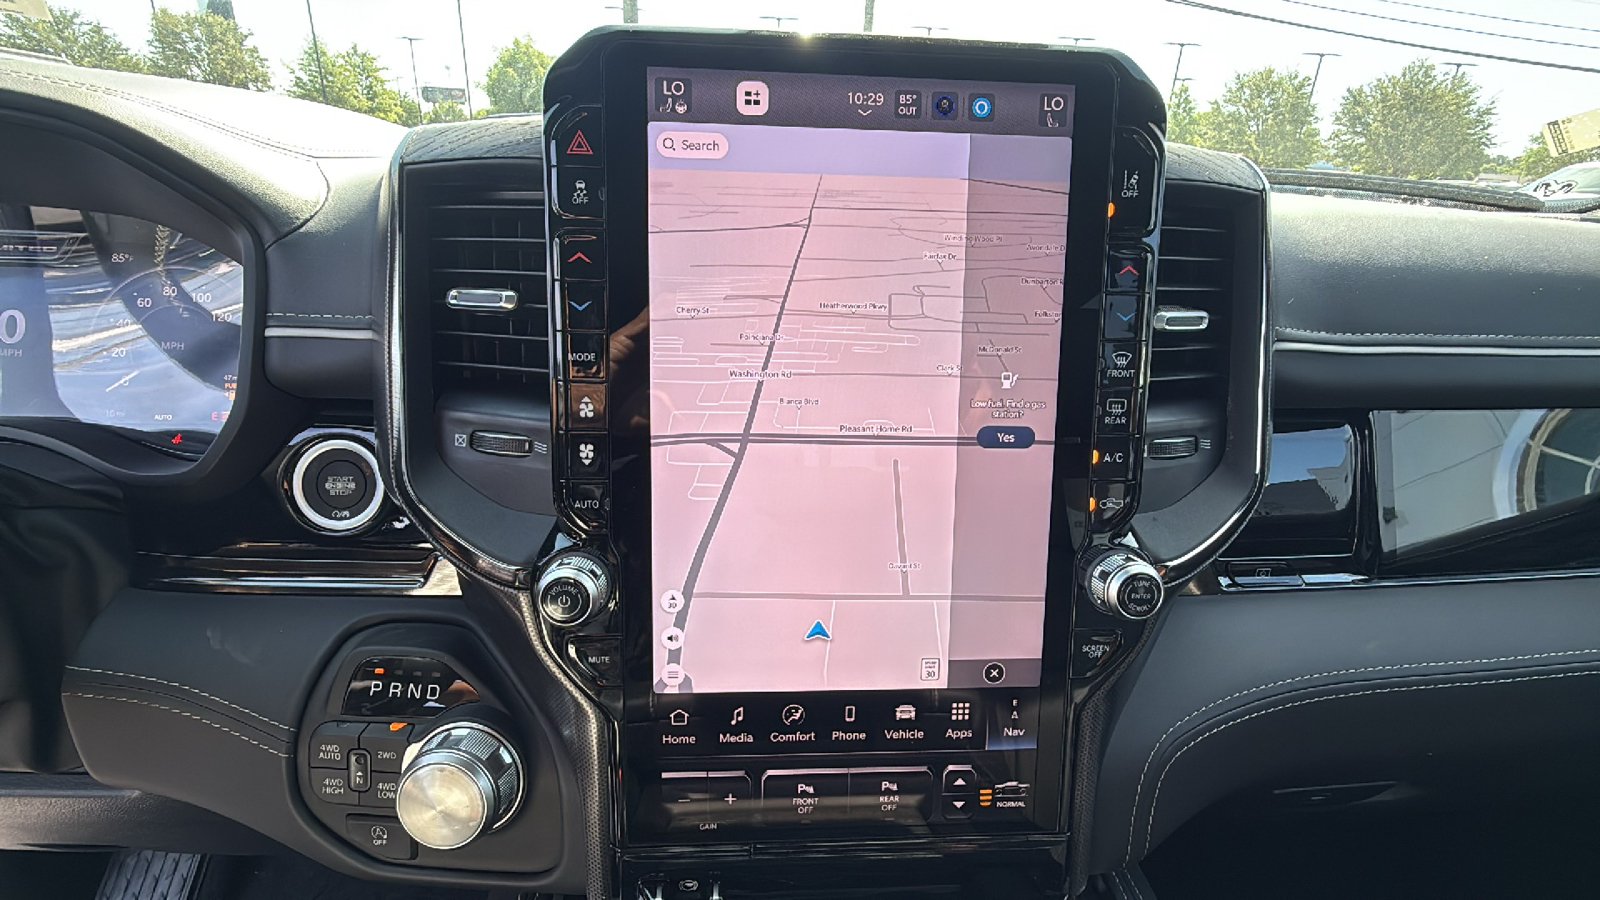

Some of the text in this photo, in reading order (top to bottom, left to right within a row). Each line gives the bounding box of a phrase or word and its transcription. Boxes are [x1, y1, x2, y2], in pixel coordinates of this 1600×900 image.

[662, 80, 685, 96] LO
[847, 92, 884, 106] 10:29
[899, 94, 916, 104] 85°
[1043, 96, 1064, 112] LO
[898, 106, 918, 116] OUT
[681, 138, 720, 152] Search
[1122, 190, 1139, 198] OFF
[572, 196, 589, 205] OFF
[162, 286, 178, 296] 80
[191, 292, 212, 303] 100
[136, 298, 152, 308] 60
[820, 302, 887, 311] Heatherwood Pkwy
[676, 306, 710, 315] Cherry St
[211, 312, 232, 323] 120
[116, 318, 131, 328] 40
[739, 333, 774, 341] Poinciana
[162, 342, 185, 350] MPH
[111, 348, 126, 358] 20
[568, 352, 596, 362] MODE
[729, 370, 792, 379] Washington Rd
[1106, 370, 1136, 378] FRONT
[970, 400, 986, 408] Low
[1006, 400, 1024, 408] Find
[1031, 402, 1046, 410] gas
[211, 411, 218, 420] E
[992, 410, 1024, 419] station?
[840, 424, 874, 434] Pleasant
[875, 425, 900, 433] Home
[997, 432, 1015, 443] Yes
[1103, 452, 1124, 463] A/C
[574, 500, 600, 509] AUTO
[549, 584, 579, 596] VOLUME
[770, 732, 816, 742] Comfort
[832, 730, 867, 741] Phone
[885, 729, 924, 740] Vehicle
[945, 728, 973, 740] Apps
[1004, 727, 1025, 737] Nav
[662, 734, 696, 744] Home
[719, 733, 754, 743] Media
[320, 744, 340, 753] 4WD
[318, 753, 341, 761] AUTO
[378, 752, 397, 760] 2WD
[323, 778, 344, 786] 4WD
[377, 782, 396, 791] 4WD
[322, 786, 344, 795] HIGH
[378, 791, 396, 799] LOW
[792, 798, 820, 806] FRONT
